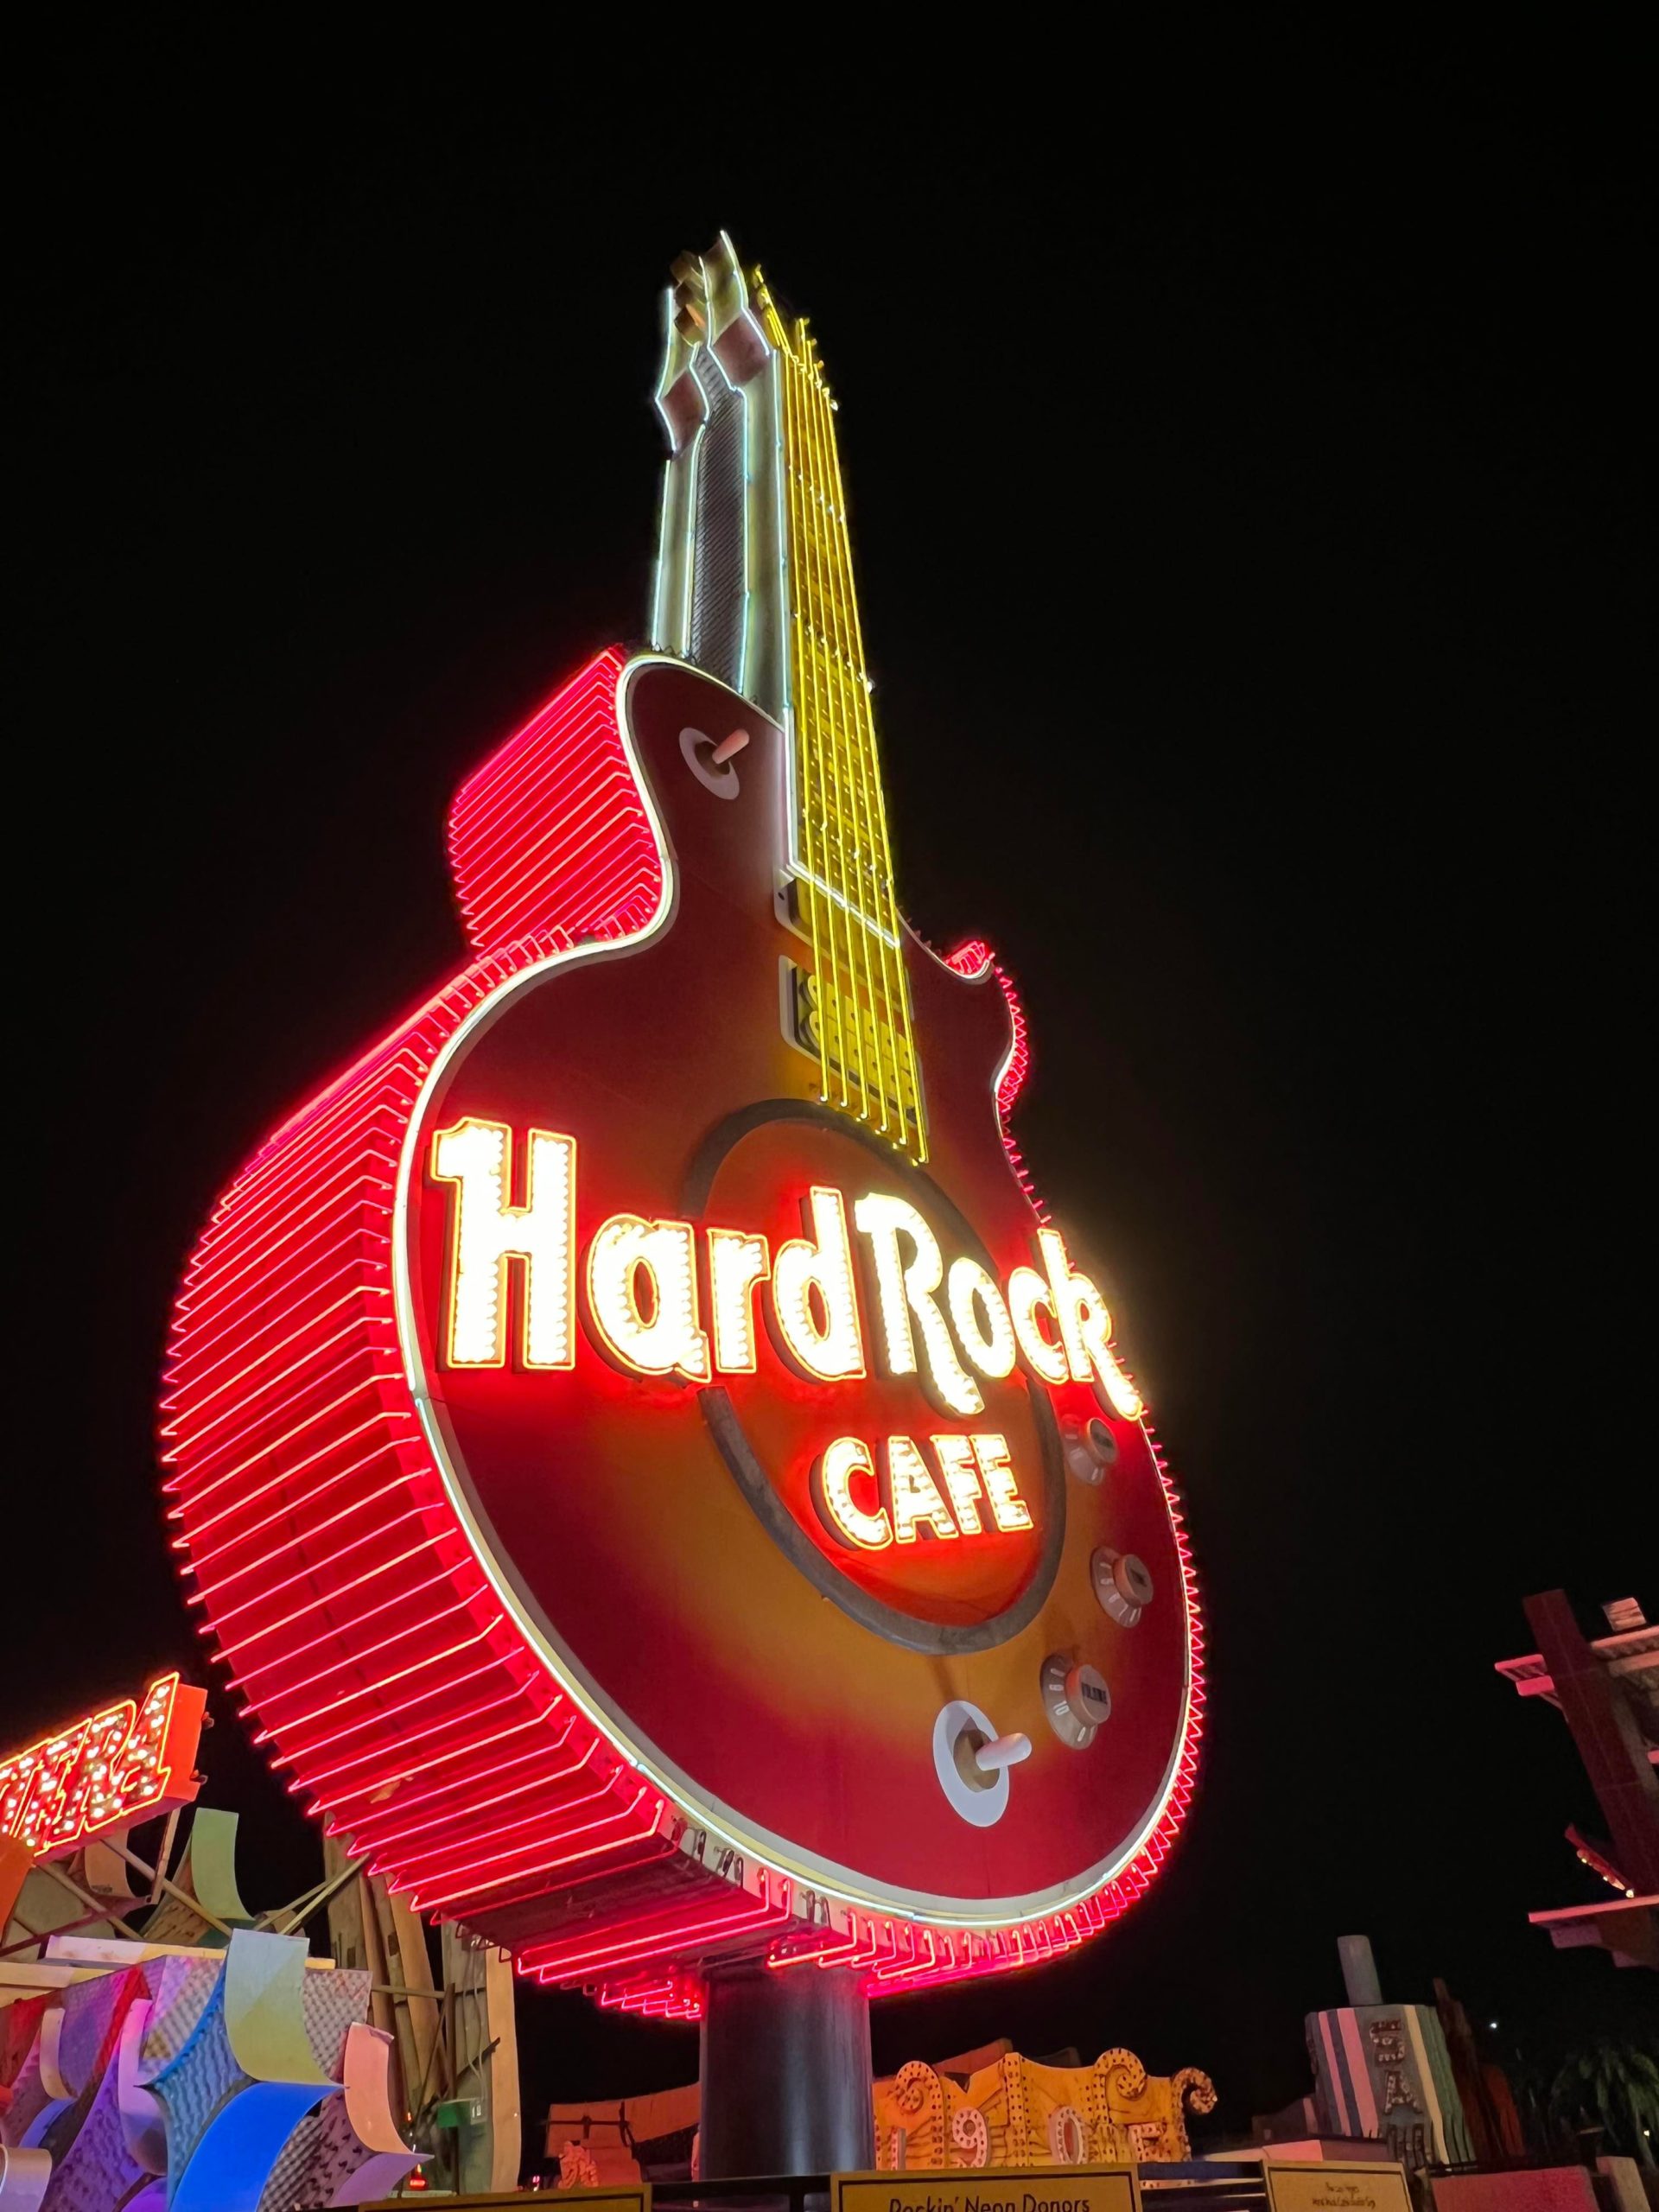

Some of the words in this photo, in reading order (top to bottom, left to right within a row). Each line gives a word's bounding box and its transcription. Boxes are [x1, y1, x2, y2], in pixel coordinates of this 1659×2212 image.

[430, 1116, 867, 1383] Hard
[854, 1192, 1143, 1421] Rock
[822, 1433, 1034, 1551] CAFE
[965, 2196, 1015, 2212] Neon
[1023, 2194, 1090, 2212] Donors
